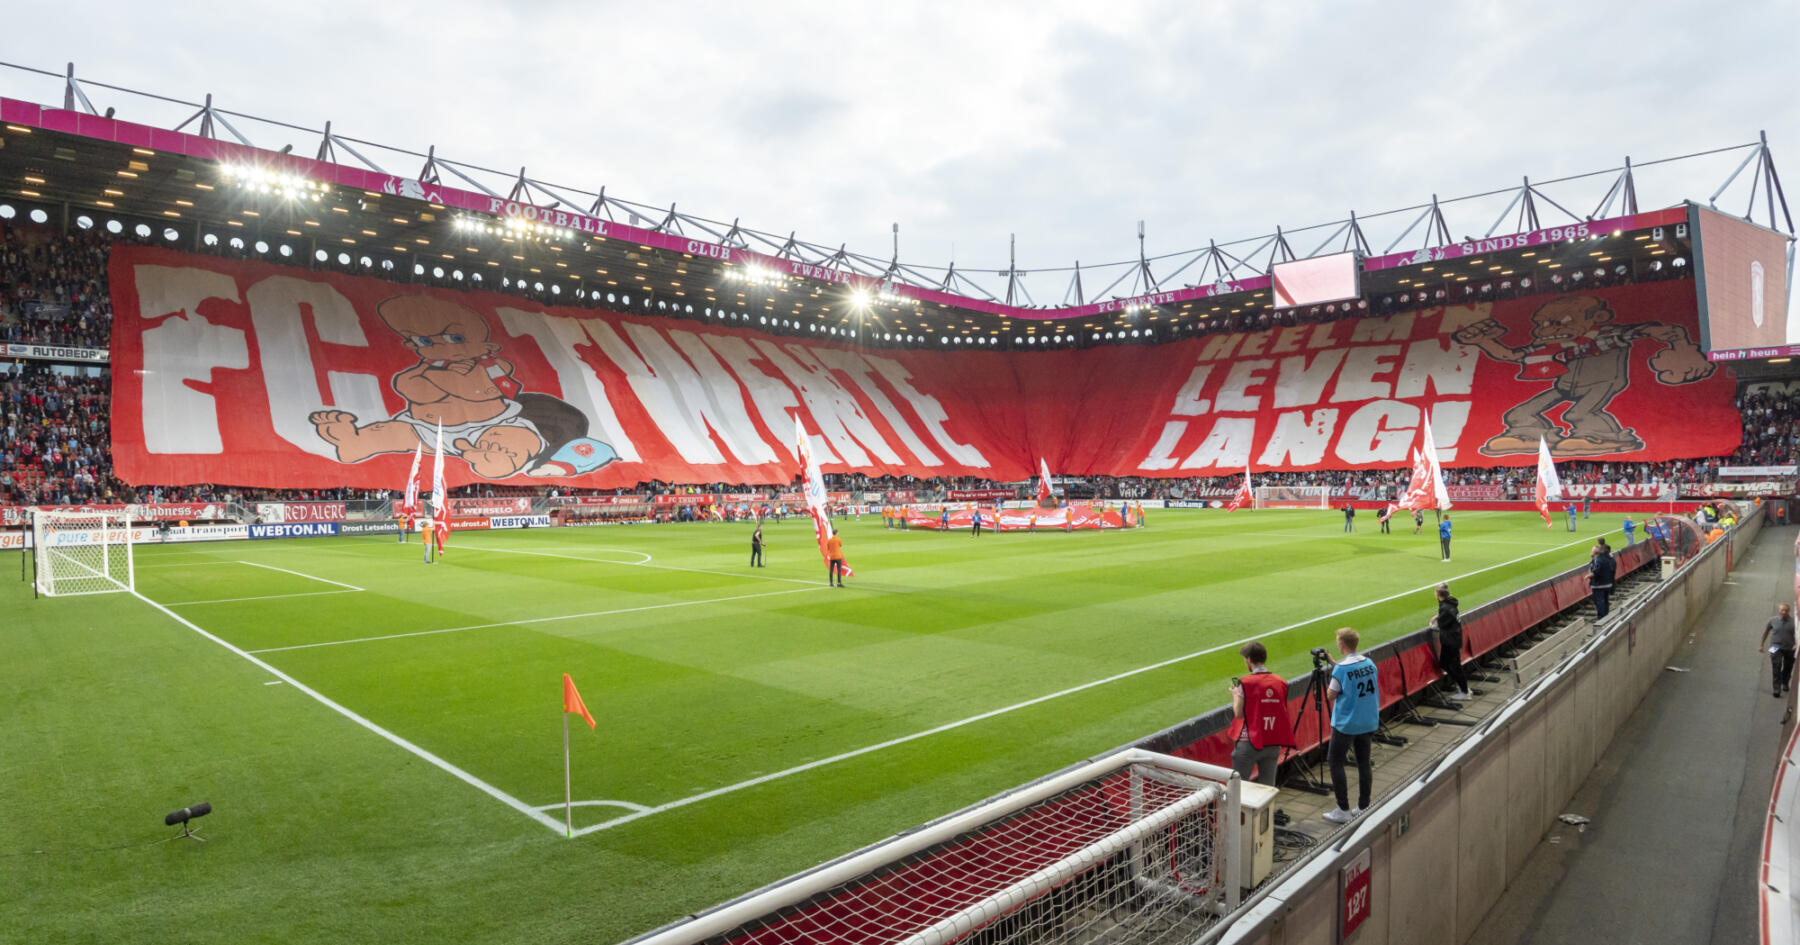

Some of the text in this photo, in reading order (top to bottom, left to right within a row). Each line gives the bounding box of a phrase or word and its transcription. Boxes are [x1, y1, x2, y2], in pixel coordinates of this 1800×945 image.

[490, 198, 852, 283] FOOTBALL CLUB TWENTE
[1462, 224, 1589, 255] SINDS 1965
[1098, 293, 1175, 312] FC TWENTE
[1198, 321, 1337, 362] HEEL
[1712, 352, 1736, 360] hein
[1750, 349, 1779, 358] heun
[134, 263, 991, 467] FC TWENTE
[1170, 338, 1480, 416] LEVEN
[1137, 399, 1472, 471] LANG!
[1120, 488, 1147, 498] VAK-P
[139, 504, 193, 521] Madness
[284, 504, 345, 521] RED ALERT
[251, 523, 335, 537] WEBTON.NL
[342, 525, 363, 533] Drost
[492, 515, 550, 528] WEBTON.NL
[57, 532, 89, 546] pure
[1347, 666, 1375, 681] PRESS
[1357, 679, 1376, 699] 24
[1263, 716, 1277, 731] TV
[1347, 883, 1367, 922] 127
